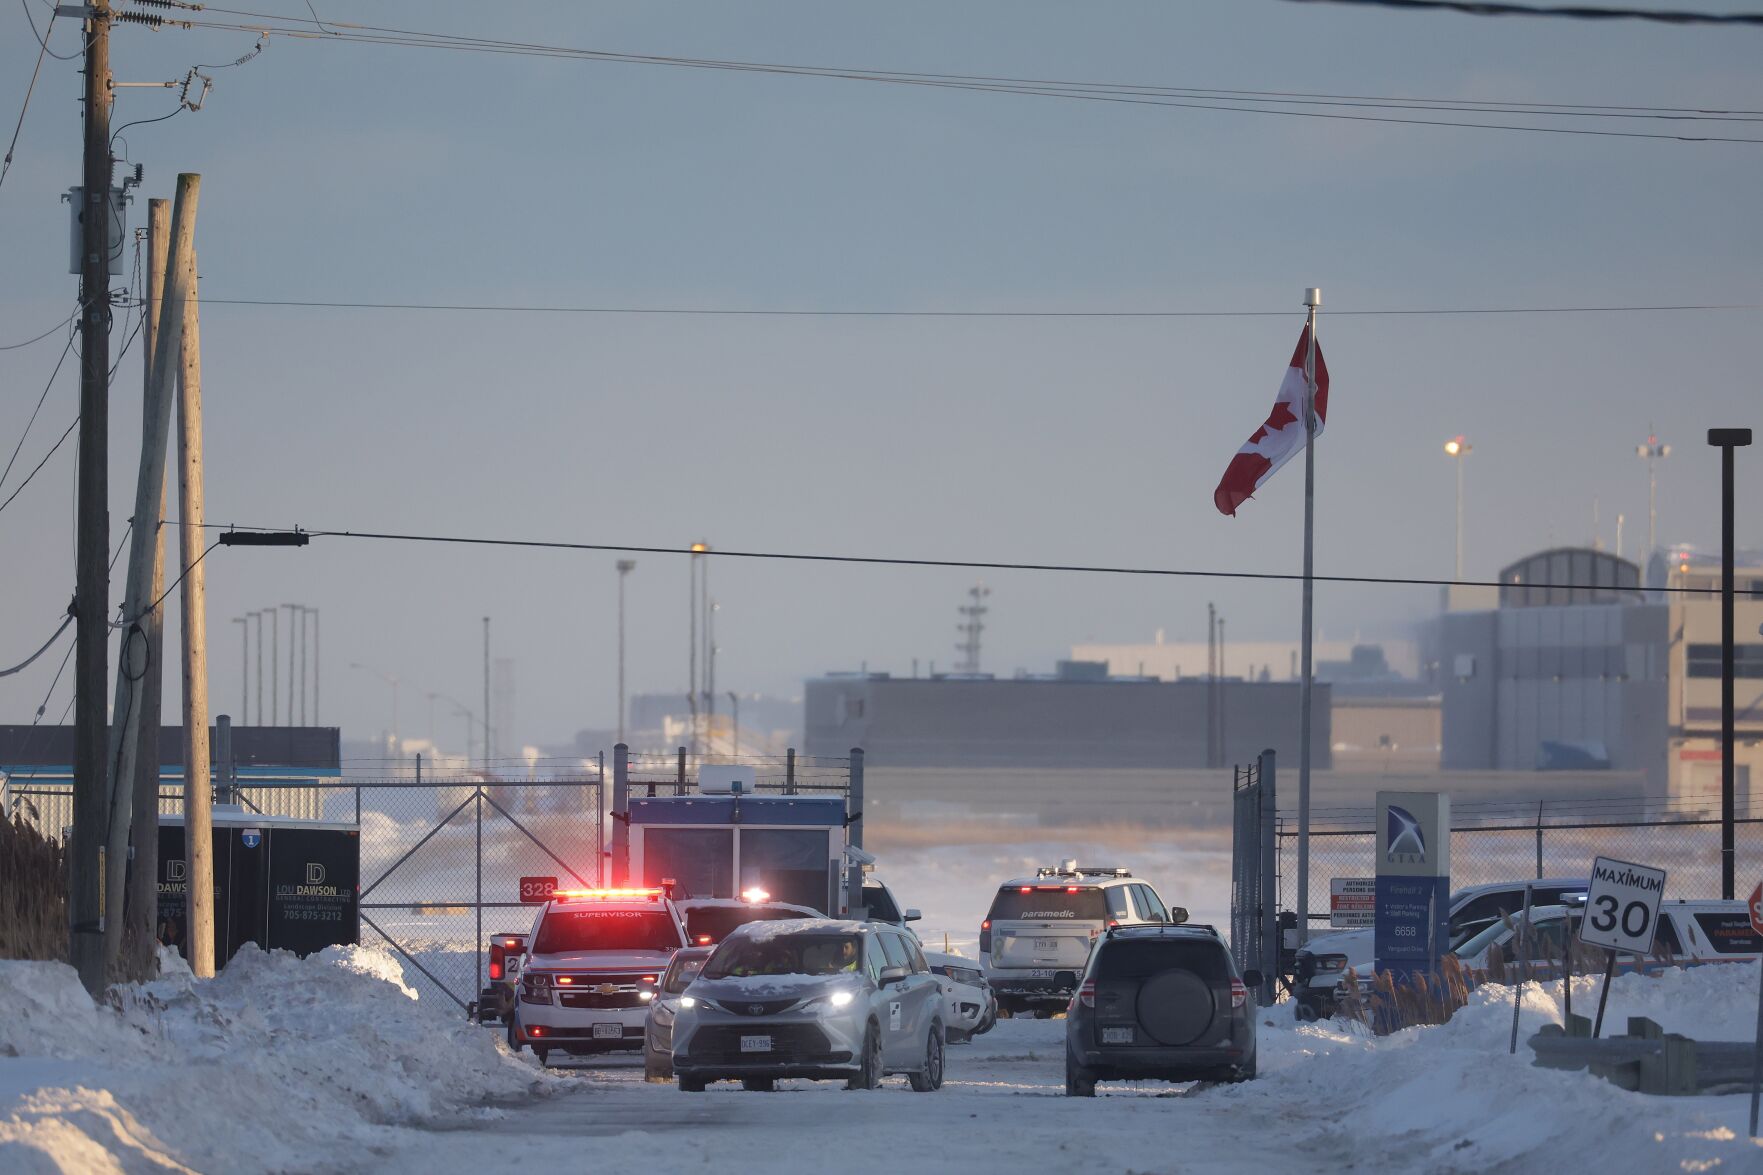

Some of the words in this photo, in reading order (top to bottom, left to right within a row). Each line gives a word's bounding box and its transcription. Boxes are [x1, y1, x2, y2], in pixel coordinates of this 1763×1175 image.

[1387, 853, 1426, 864] GTAA
[1595, 866, 1662, 893] MAXIMUM
[156, 882, 187, 893] DAWS
[297, 885, 337, 896] DAWSON
[523, 882, 555, 897] 328
[573, 911, 643, 919] SUPERVISOR
[1020, 910, 1075, 920] paramedic
[1590, 895, 1650, 938] 30
[1394, 926, 1416, 937] 6658
[951, 1001, 957, 1014] 1
